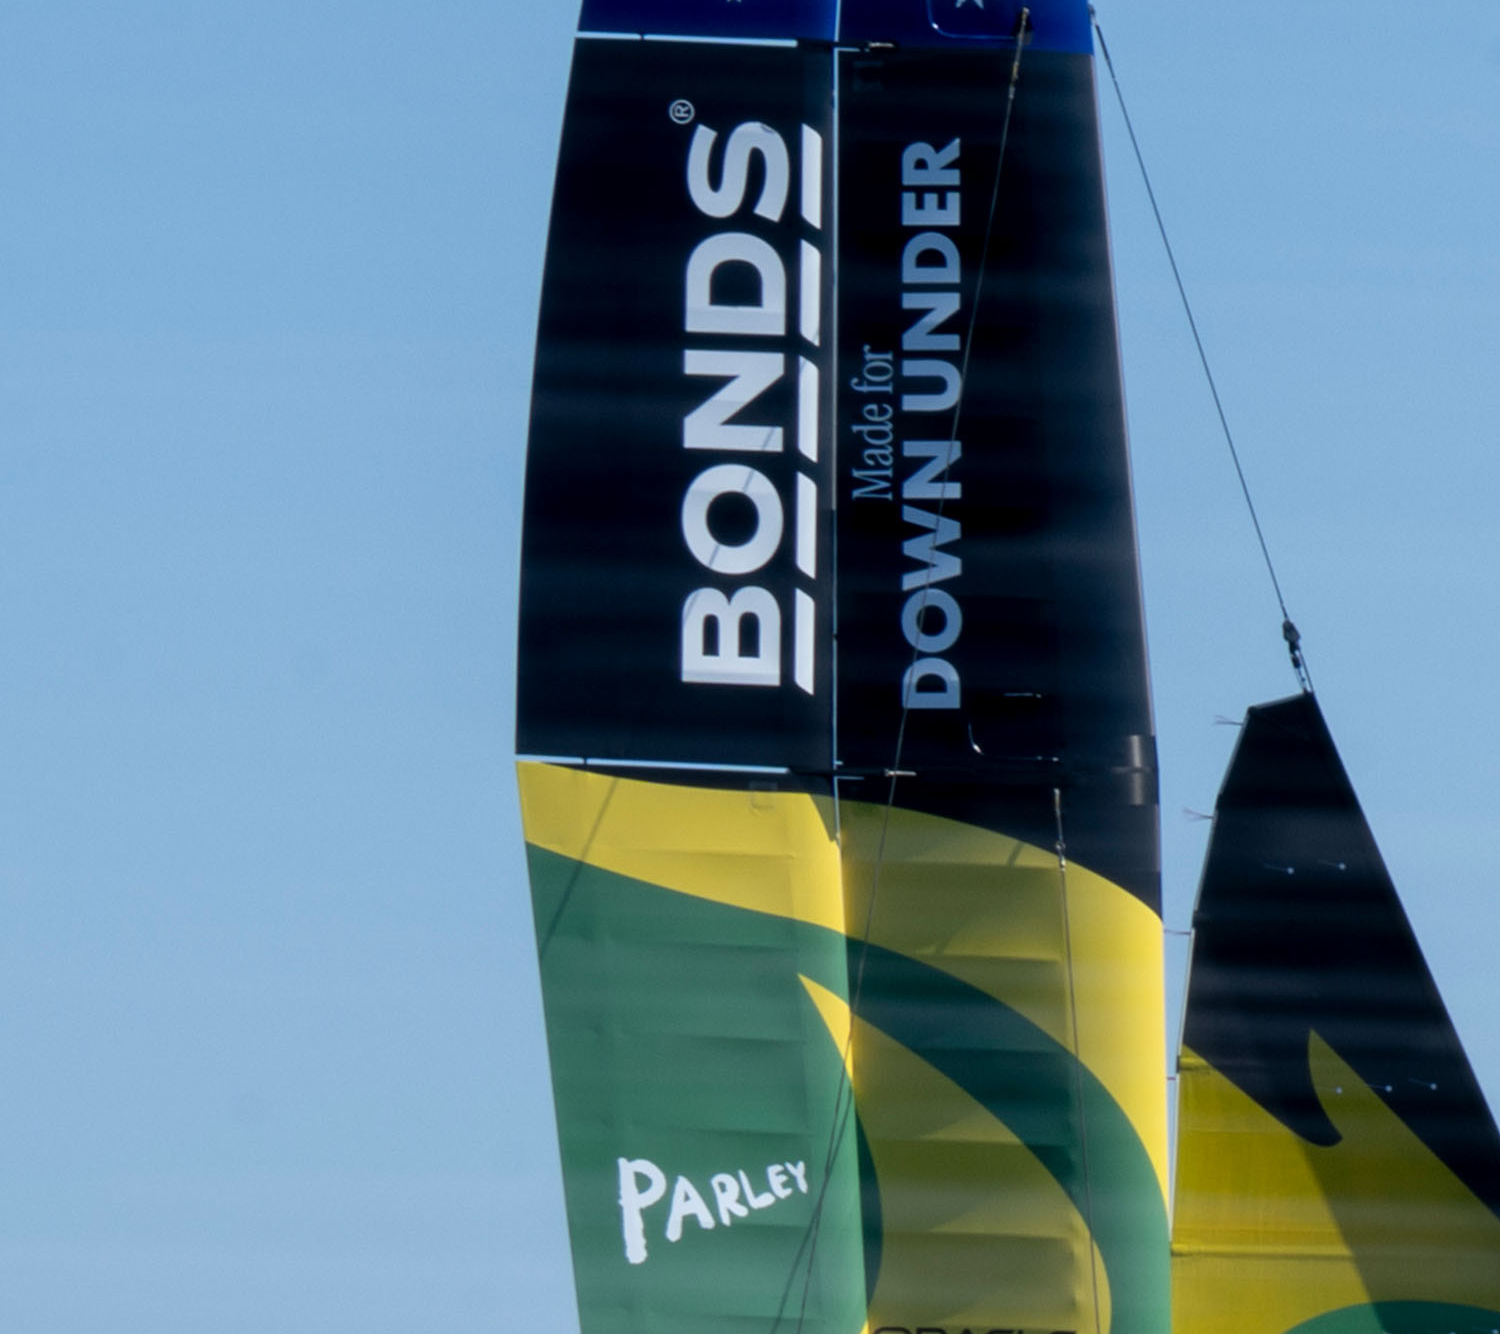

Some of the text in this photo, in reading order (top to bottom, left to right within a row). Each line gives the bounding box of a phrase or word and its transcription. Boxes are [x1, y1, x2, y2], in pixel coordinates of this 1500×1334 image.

[851, 344, 894, 501] Made for
[901, 137, 963, 710] DOWN UNDER
[617, 1156, 811, 1265] PARLEY
